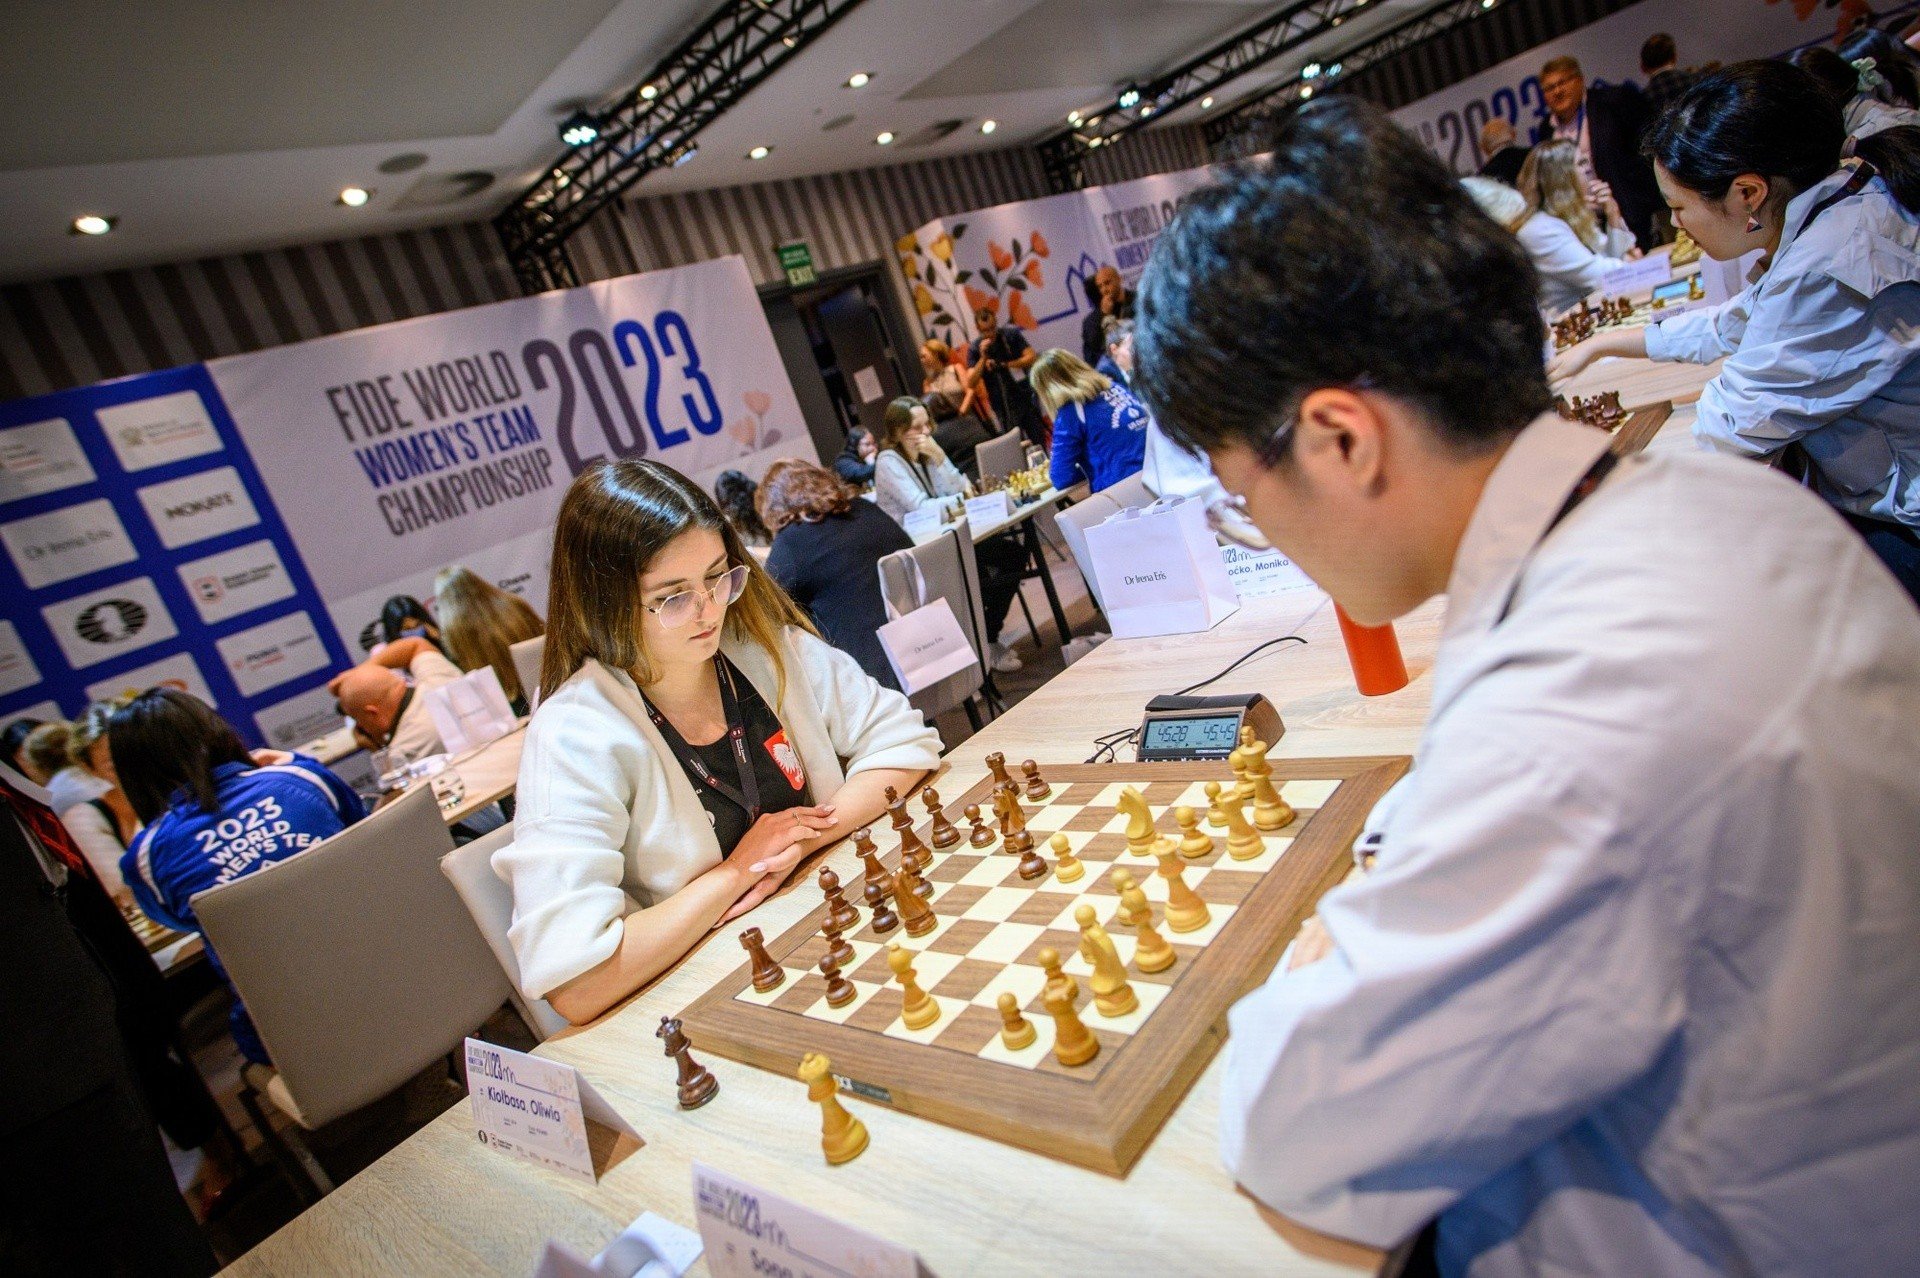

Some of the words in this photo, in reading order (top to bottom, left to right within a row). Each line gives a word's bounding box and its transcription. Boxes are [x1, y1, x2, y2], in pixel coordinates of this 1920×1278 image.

[326, 375, 412, 442] FIDE
[402, 349, 521, 420] WORLD
[522, 309, 724, 477] 2023
[354, 420, 479, 489] WOMEN'S
[480, 405, 542, 454] TEAM
[376, 448, 553, 537] CHAMPIONSHIP
[1221, 548, 1237, 564] 023
[1228, 565, 1253, 576] oćko,
[1255, 558, 1290, 571] Monika
[1124, 575, 1134, 586] Dr
[1135, 574, 1154, 584] Irena
[195, 796, 283, 853] 2023
[209, 820, 291, 866] WORLD
[214, 838, 279, 885] MEN'S
[282, 833, 324, 850] TEA
[482, 1050, 503, 1080] 2023
[530, 1099, 561, 1122] Oliwia
